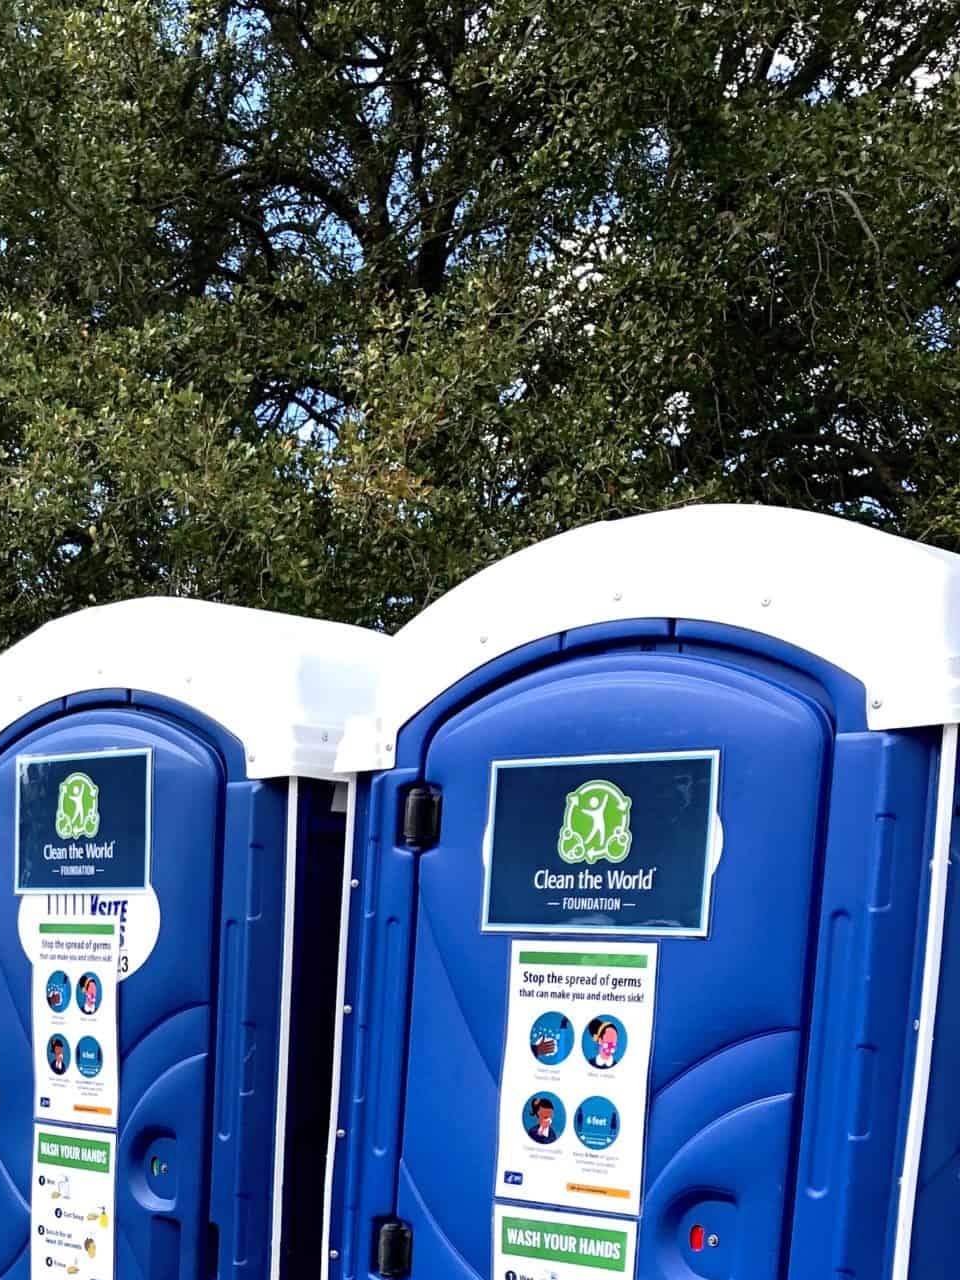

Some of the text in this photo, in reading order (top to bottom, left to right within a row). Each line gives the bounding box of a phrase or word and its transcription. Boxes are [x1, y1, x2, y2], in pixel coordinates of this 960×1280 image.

[43, 841, 113, 860] Clean the World
[534, 869, 654, 890] Clean the World
[562, 897, 621, 911] FOUNDATION
[523, 970, 642, 990] Stop the spread of germs
[519, 988, 535, 998] that
[550, 989, 571, 999] make
[572, 992, 585, 1002] you
[586, 992, 600, 1001] and
[602, 992, 626, 1002] others
[60, 1144, 80, 1160] YOUR
[81, 1147, 106, 1164] HANDS
[506, 1227, 621, 1260] WASH YOUR HANDS
